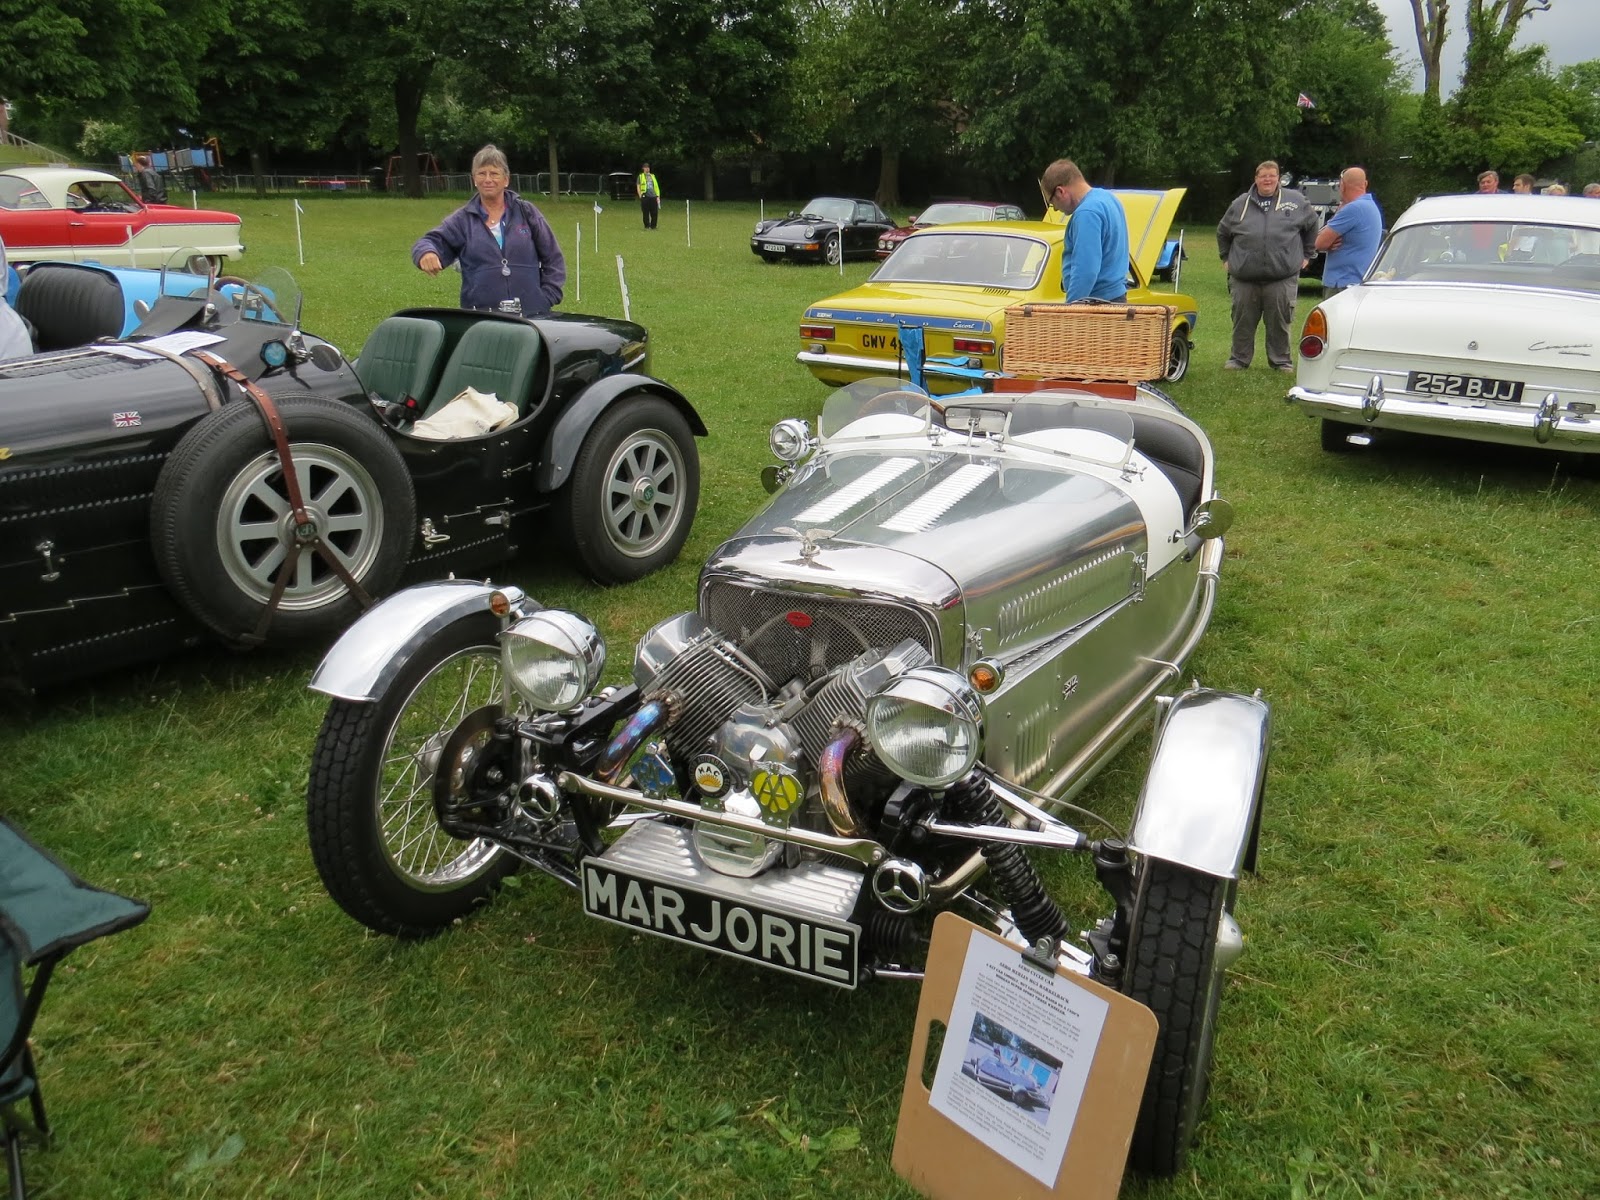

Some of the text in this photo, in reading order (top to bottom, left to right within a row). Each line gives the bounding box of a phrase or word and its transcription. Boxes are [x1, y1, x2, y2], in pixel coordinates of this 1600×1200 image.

[953, 321, 975, 329] Escort
[862, 334, 886, 348] GWV
[1415, 373, 1516, 401] 252 BJJ
[587, 868, 850, 981] MARJORIE
